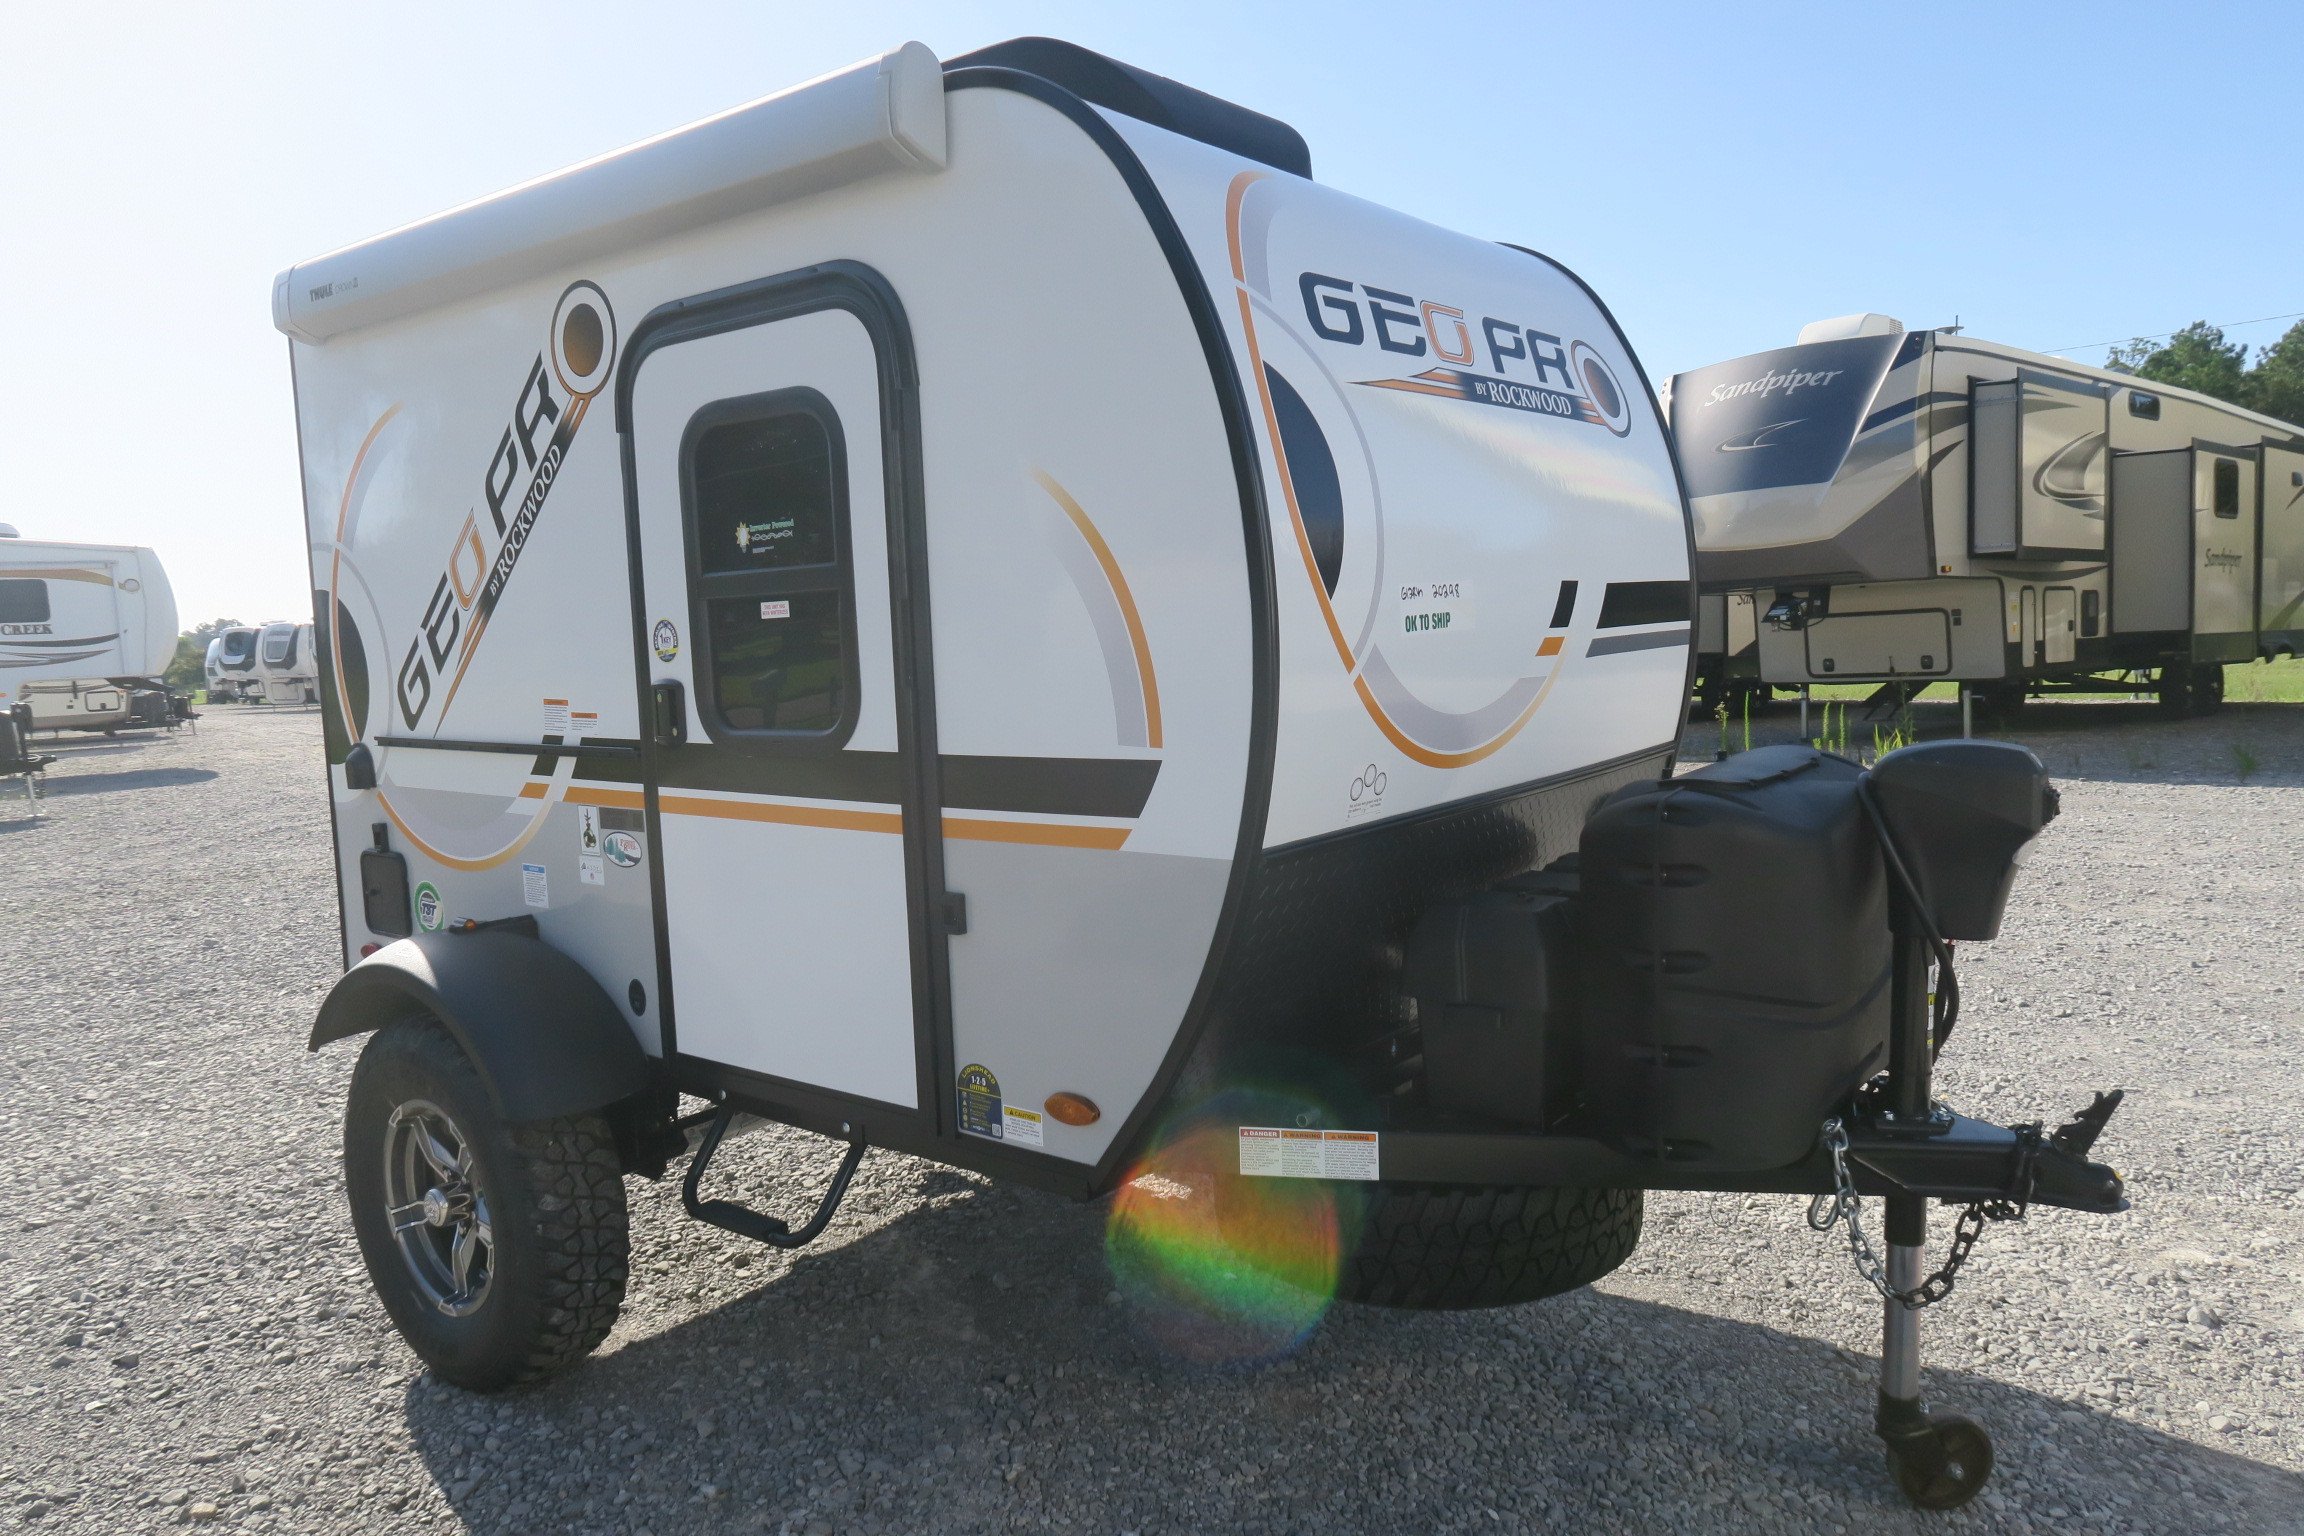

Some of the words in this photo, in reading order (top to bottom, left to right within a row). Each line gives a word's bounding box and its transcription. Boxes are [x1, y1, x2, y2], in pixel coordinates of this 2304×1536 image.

[310, 283, 334, 302] THULE
[1298, 271, 1475, 367] GEO
[1474, 382, 1487, 397] BY
[1486, 381, 1572, 416] ROCKWOOD
[1703, 368, 1844, 407] Sandpiper
[489, 576, 502, 598] BY
[496, 444, 562, 582] ROCKWOOD
[2204, 547, 2243, 574] Sandpiper
[1, 624, 53, 636] CREEK
[397, 506, 488, 732] GEO
[1405, 615, 1417, 632] OK
[1419, 613, 1429, 630] TO
[1432, 612, 1451, 629] SHIP
[962, 1065, 995, 1085] LIONSHEAD
[1014, 1111, 1036, 1121] CAUTION
